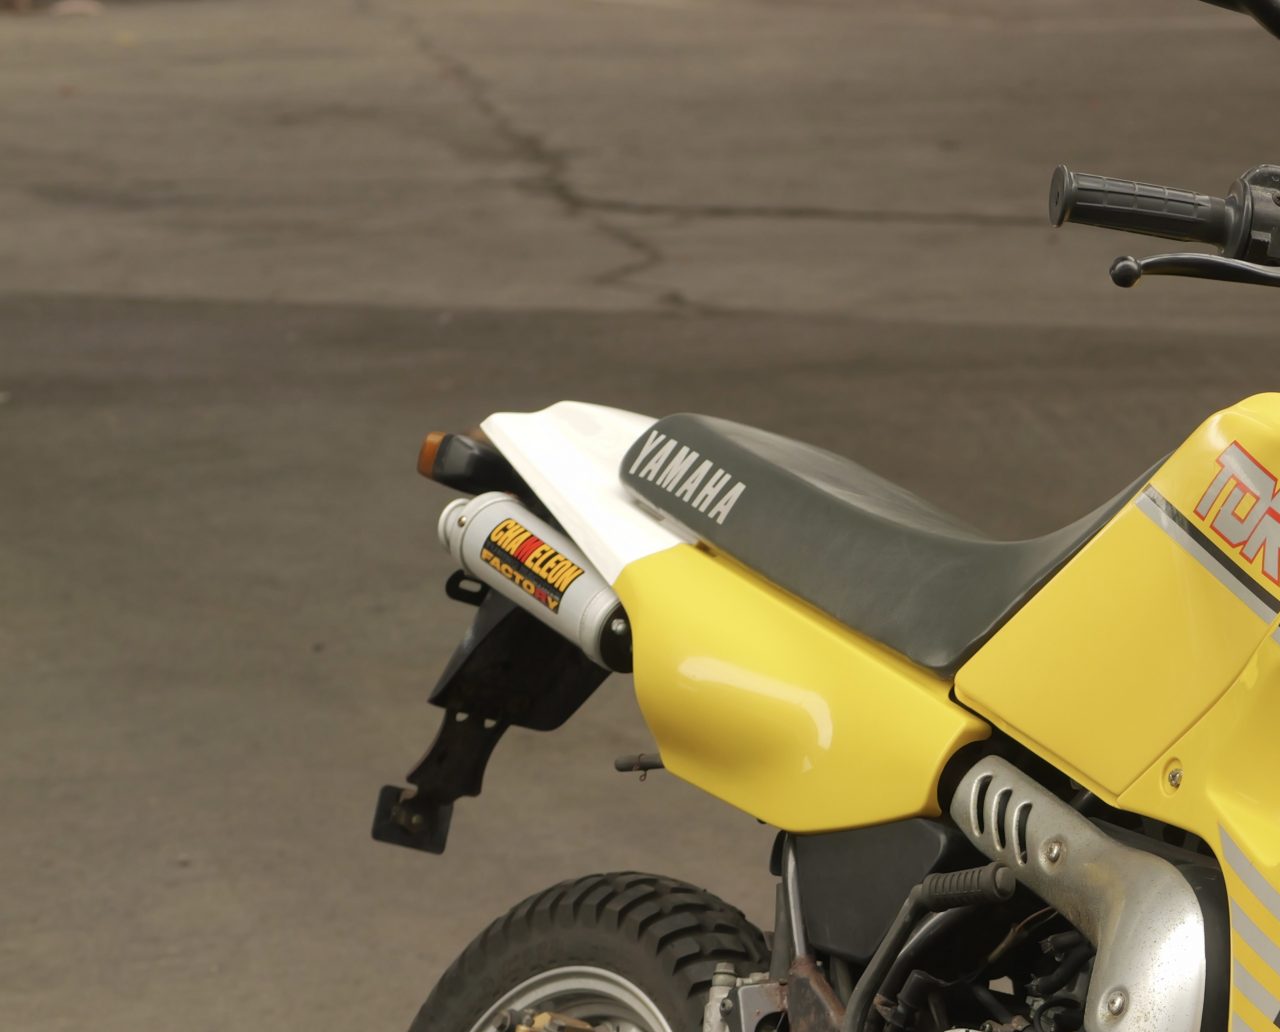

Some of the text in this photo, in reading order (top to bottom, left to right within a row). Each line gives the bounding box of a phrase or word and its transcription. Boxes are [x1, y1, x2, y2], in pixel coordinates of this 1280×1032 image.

[629, 430, 746, 525] YAMAHA
[481, 548, 559, 610] FACTORY
[490, 518, 585, 593] CHAMELEON
